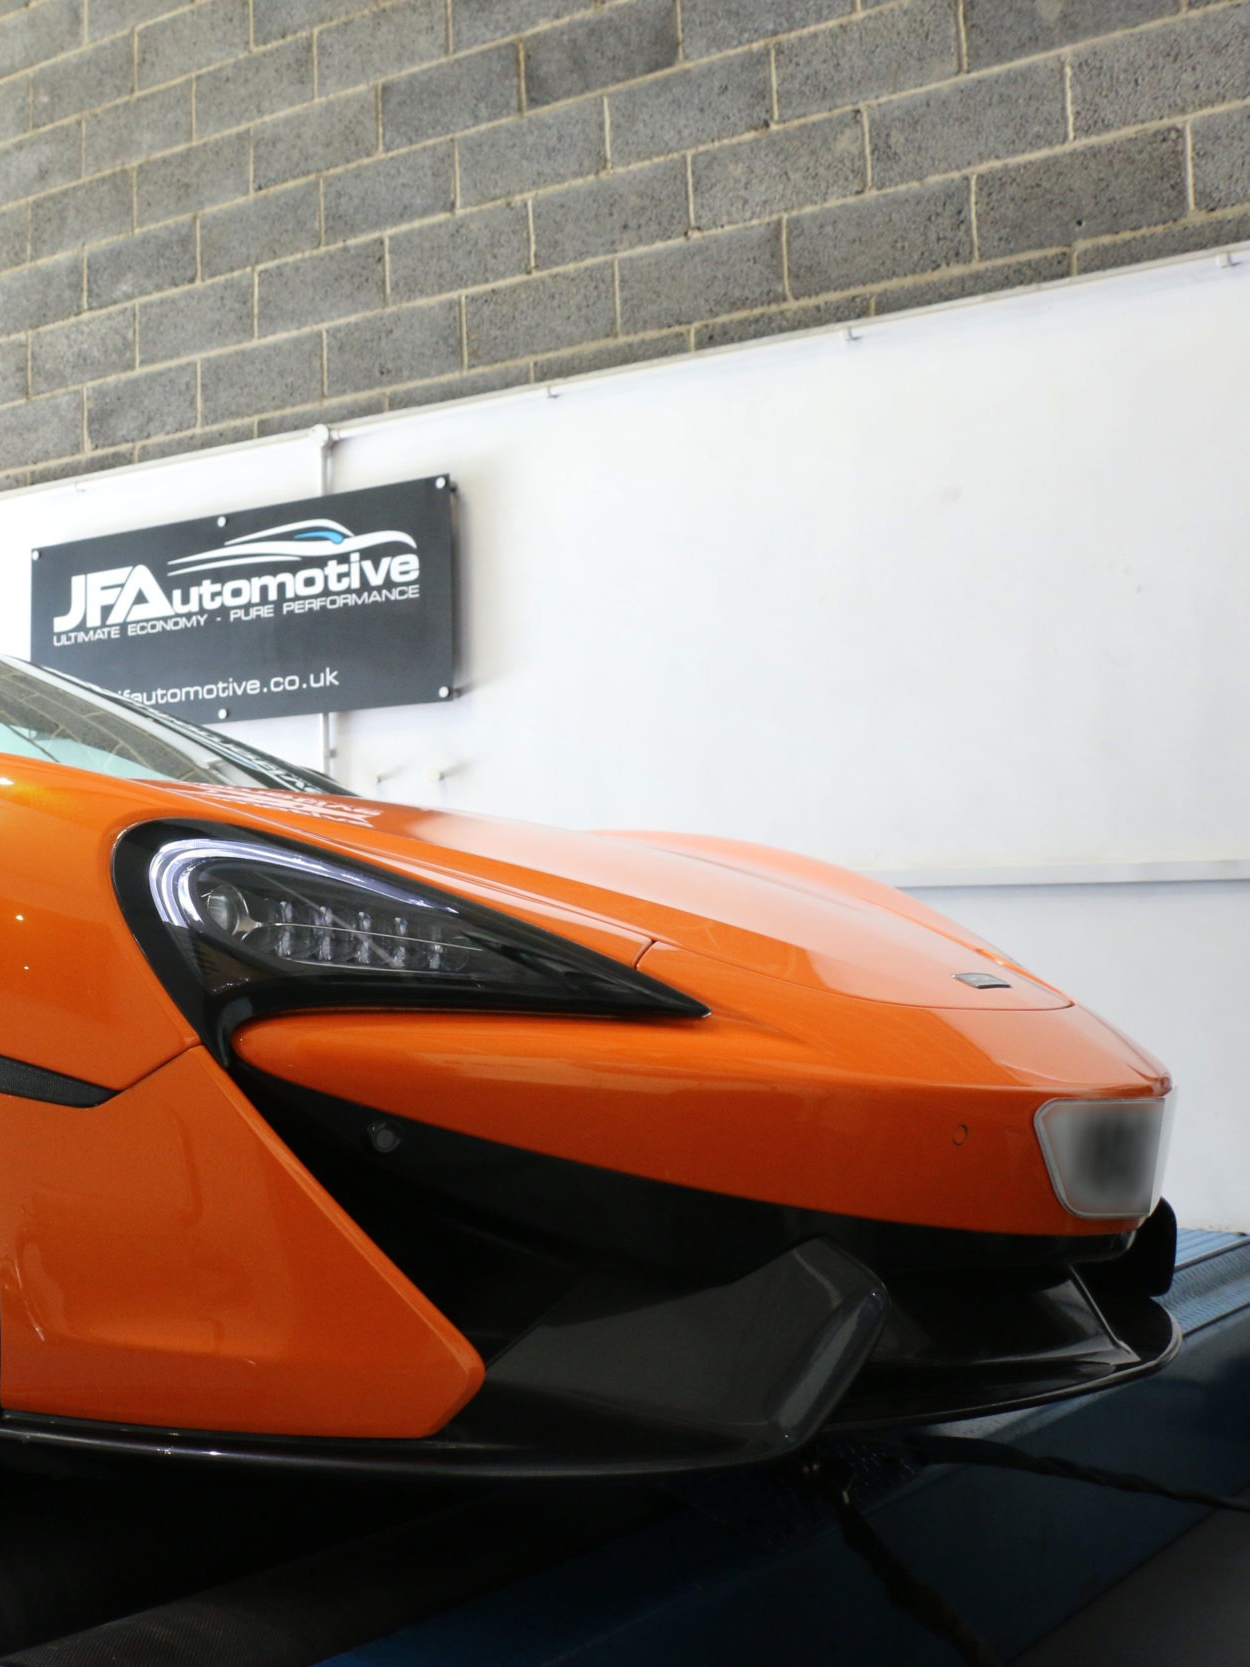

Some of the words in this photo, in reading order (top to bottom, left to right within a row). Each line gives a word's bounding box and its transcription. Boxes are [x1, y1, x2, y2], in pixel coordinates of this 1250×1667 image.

[53, 625, 120, 646] ULTIMATE
[128, 613, 208, 636] ECONOMY
[230, 604, 274, 622] PURE
[283, 585, 420, 615] PERFORMANCE
[118, 667, 339, 705] fautomotive.co.uk
